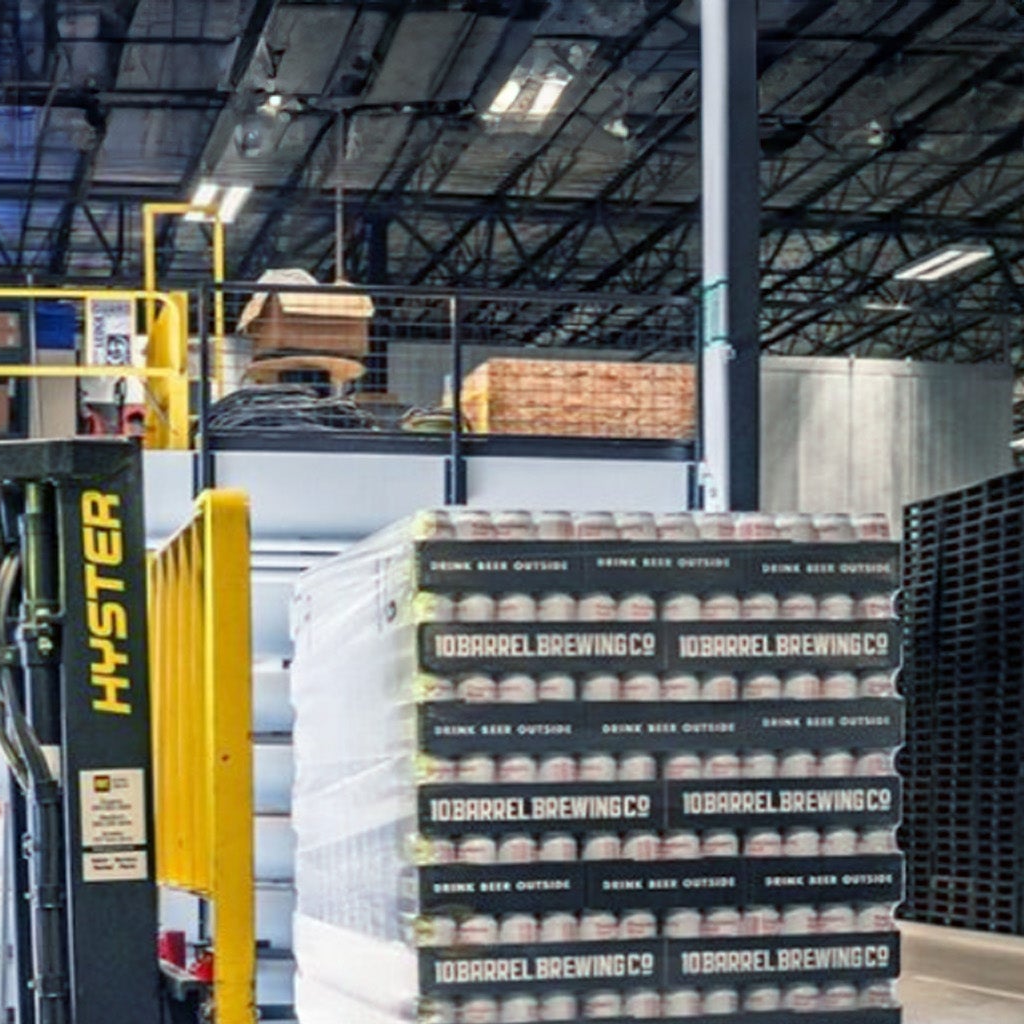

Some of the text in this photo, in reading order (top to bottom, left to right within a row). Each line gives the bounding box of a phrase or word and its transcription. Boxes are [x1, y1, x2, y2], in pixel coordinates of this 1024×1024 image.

[429, 560, 472, 572] DRINK
[512, 560, 568, 571] OUTSIDE
[596, 557, 637, 568] DRINK
[676, 557, 730, 568] OUTSIDE
[761, 563, 801, 574] DRINK
[838, 562, 892, 574] OUTSIDE
[82, 490, 131, 714] HYSTER
[761, 717, 801, 728] DRINK
[838, 715, 891, 727] OUTSIDE
[434, 725, 476, 736] DRINK
[516, 724, 572, 735] OUTSIDE
[601, 723, 643, 734] DRINK
[681, 722, 736, 733] OUTSIDE
[602, 879, 643, 890] DRINK
[681, 876, 736, 889] OUTSIDE
[764, 876, 805, 887] DRINK
[841, 873, 893, 885] OUTSIDE
[432, 882, 475, 894] DRINK
[515, 879, 571, 891] OUTSIDE
